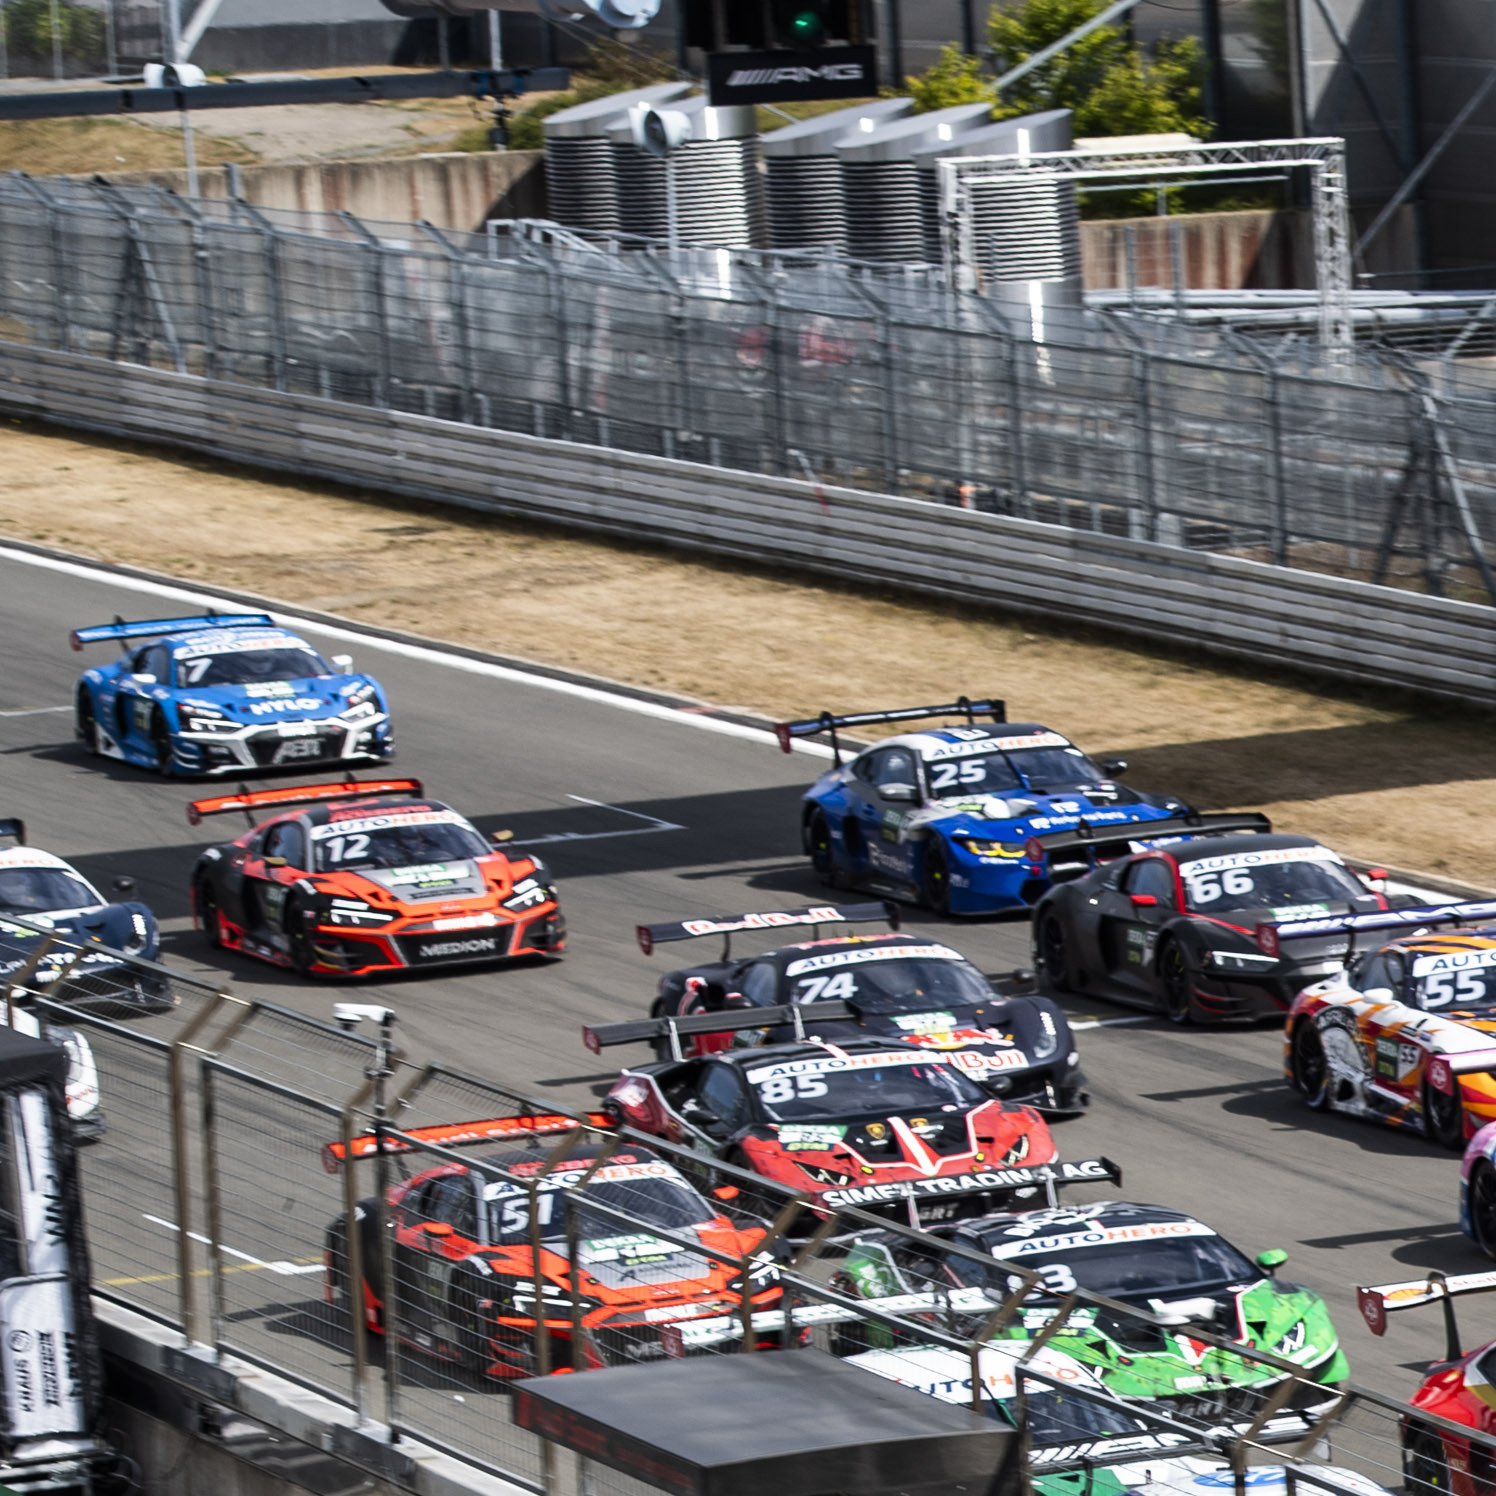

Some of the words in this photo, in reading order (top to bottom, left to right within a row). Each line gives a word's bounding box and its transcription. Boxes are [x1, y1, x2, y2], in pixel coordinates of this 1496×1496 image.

[185, 657, 213, 683] 7
[930, 759, 987, 790] 25
[325, 834, 371, 863] 12
[1190, 848, 1327, 873] AUTOHERO
[1191, 868, 1255, 904] 66
[420, 938, 497, 957] MEDION
[797, 972, 859, 1006] 74
[1426, 968, 1487, 1008] 55
[770, 1053, 925, 1077] AUTOHERO
[960, 1051, 1024, 1069] Bull
[759, 1073, 829, 1104] 85
[497, 1164, 667, 1196] ATOHERO
[1061, 1161, 1108, 1179] AG
[501, 1193, 554, 1235] 51
[1018, 1225, 1192, 1253] AUTOHERO
